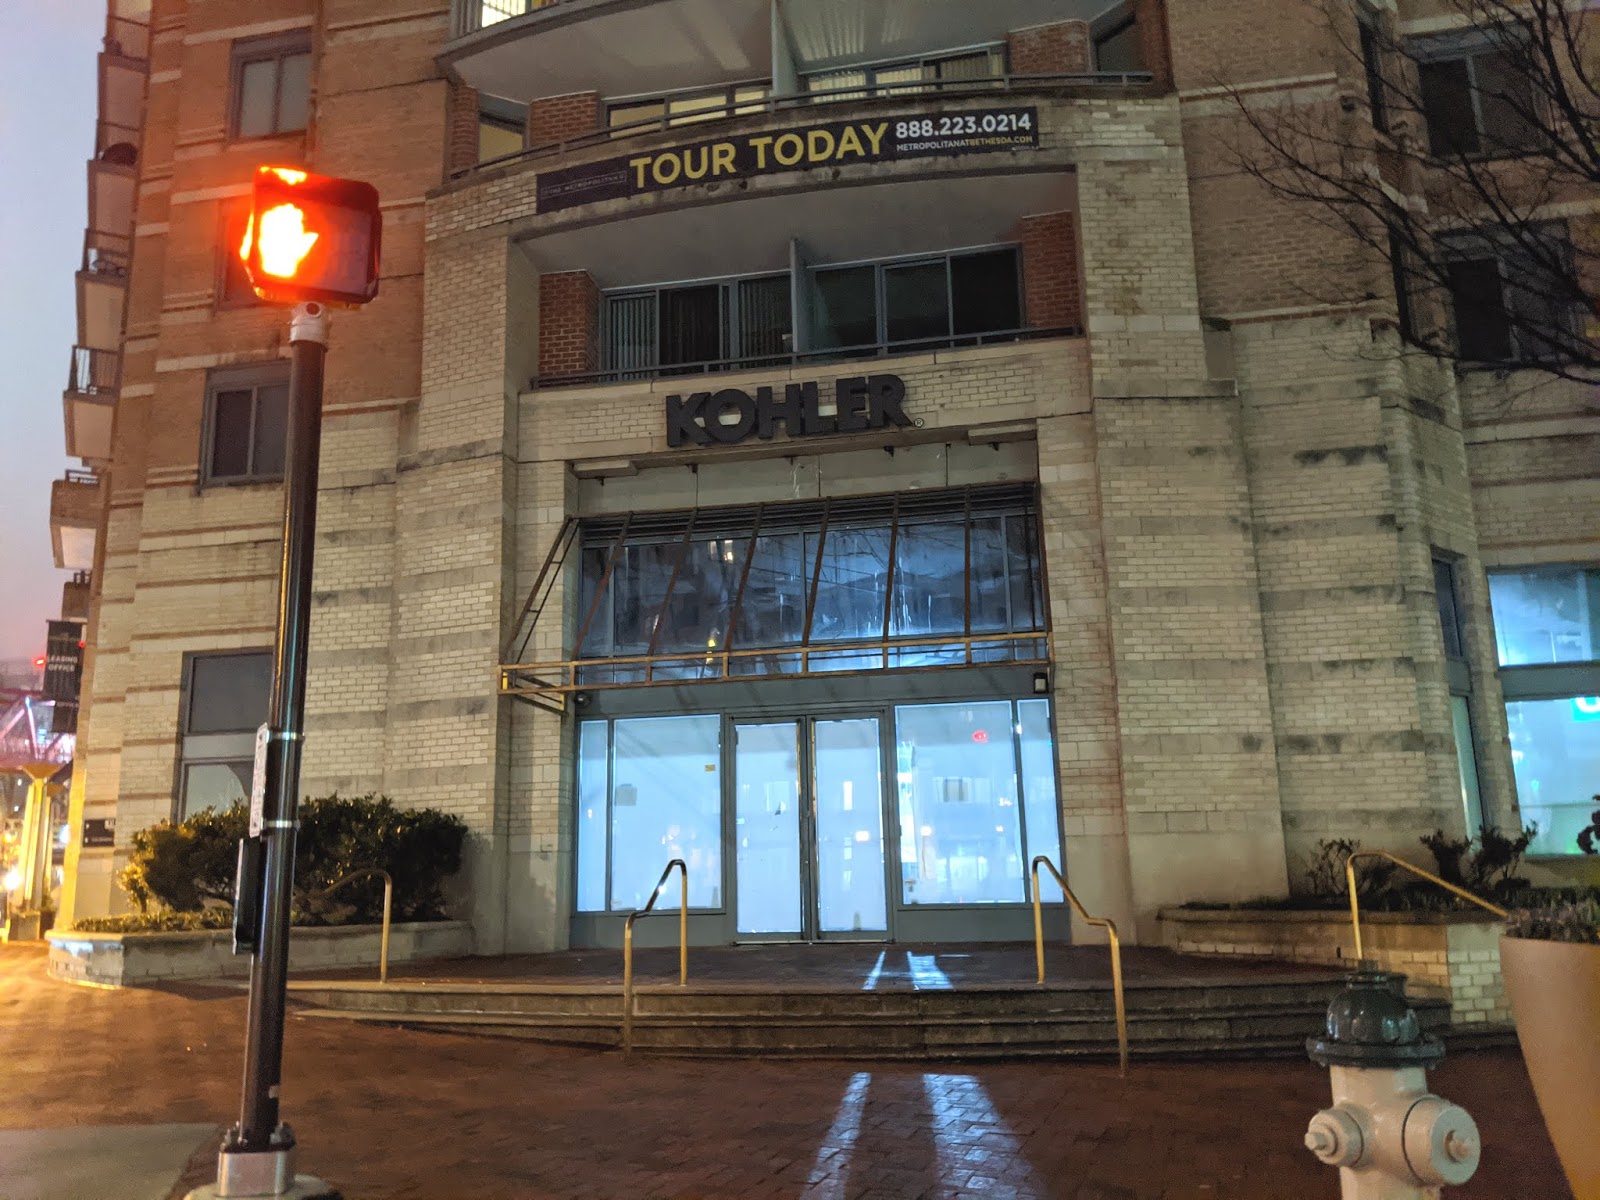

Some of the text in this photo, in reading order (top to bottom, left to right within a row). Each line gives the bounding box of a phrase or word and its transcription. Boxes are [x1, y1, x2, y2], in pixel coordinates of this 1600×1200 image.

[896, 113, 1032, 138] 888.223.0214
[629, 122, 888, 189] TOUR TODAY
[666, 374, 914, 447] KOHLER
[47, 655, 78, 664] LEASING
[48, 664, 76, 672] OFFICE
